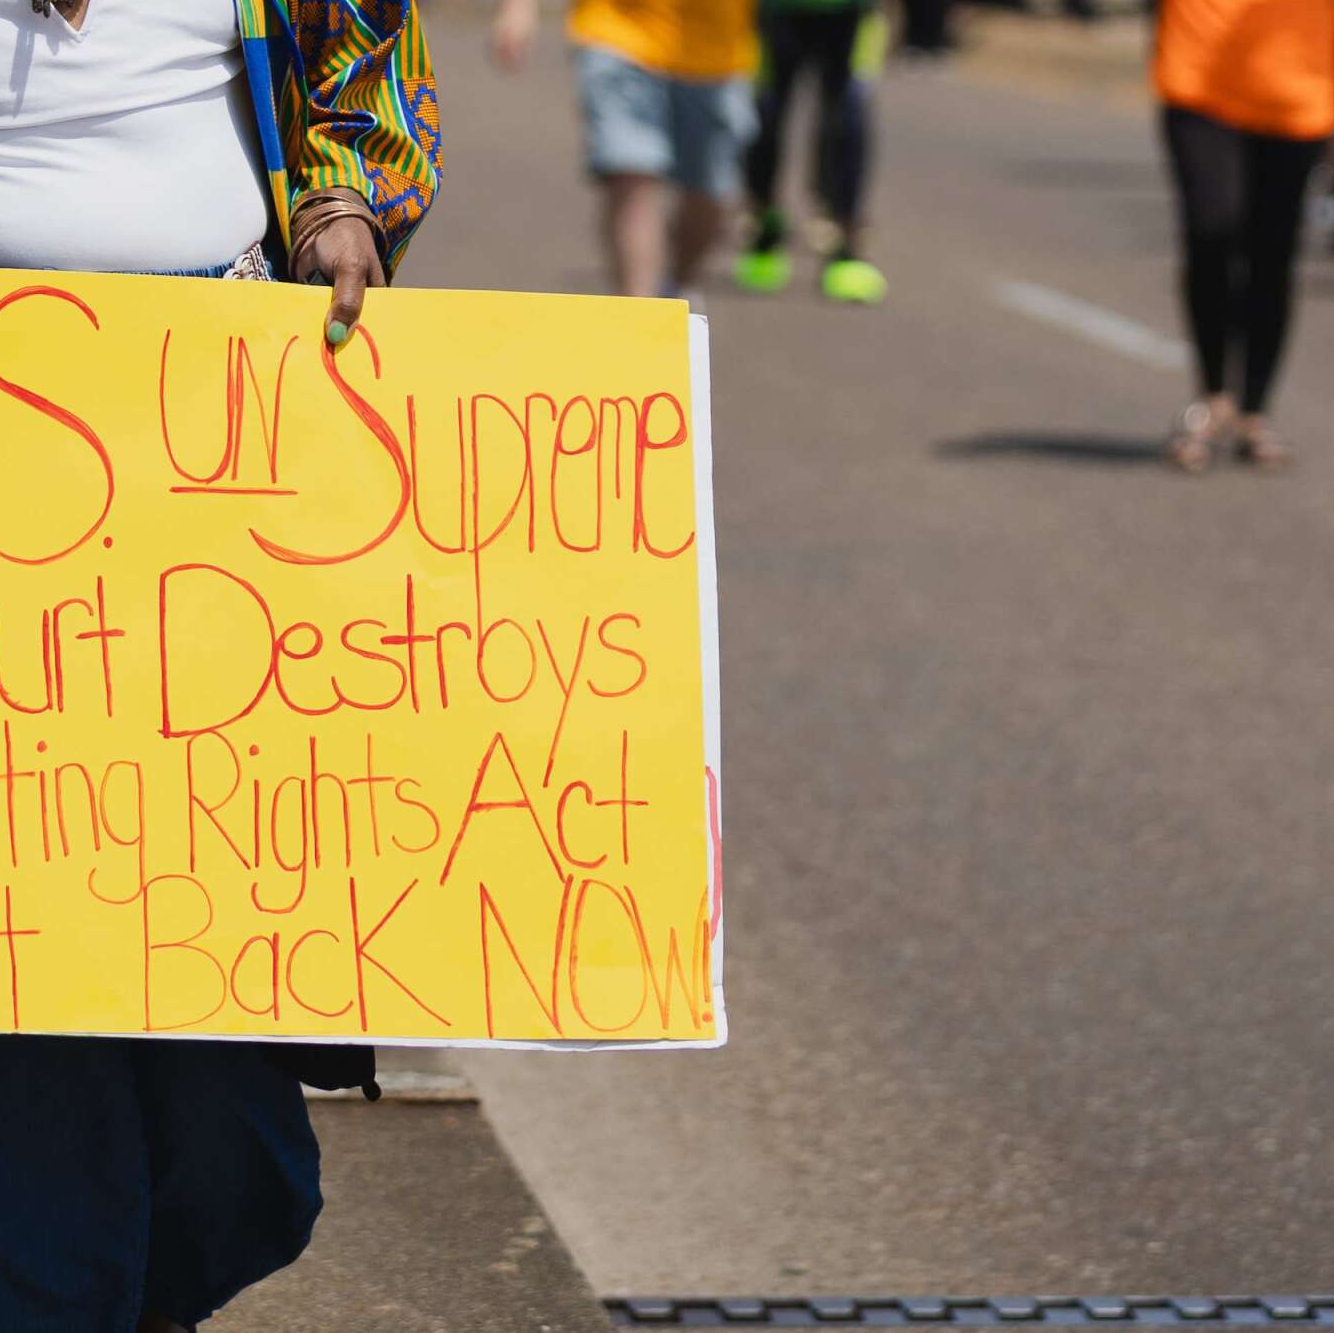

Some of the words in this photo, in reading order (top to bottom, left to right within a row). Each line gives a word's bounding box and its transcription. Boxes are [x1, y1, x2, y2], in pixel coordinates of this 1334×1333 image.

[250, 322, 697, 582] Supreme
[157, 561, 649, 789] Destroys
[188, 729, 441, 914] Rights
[440, 730, 650, 886] Act
